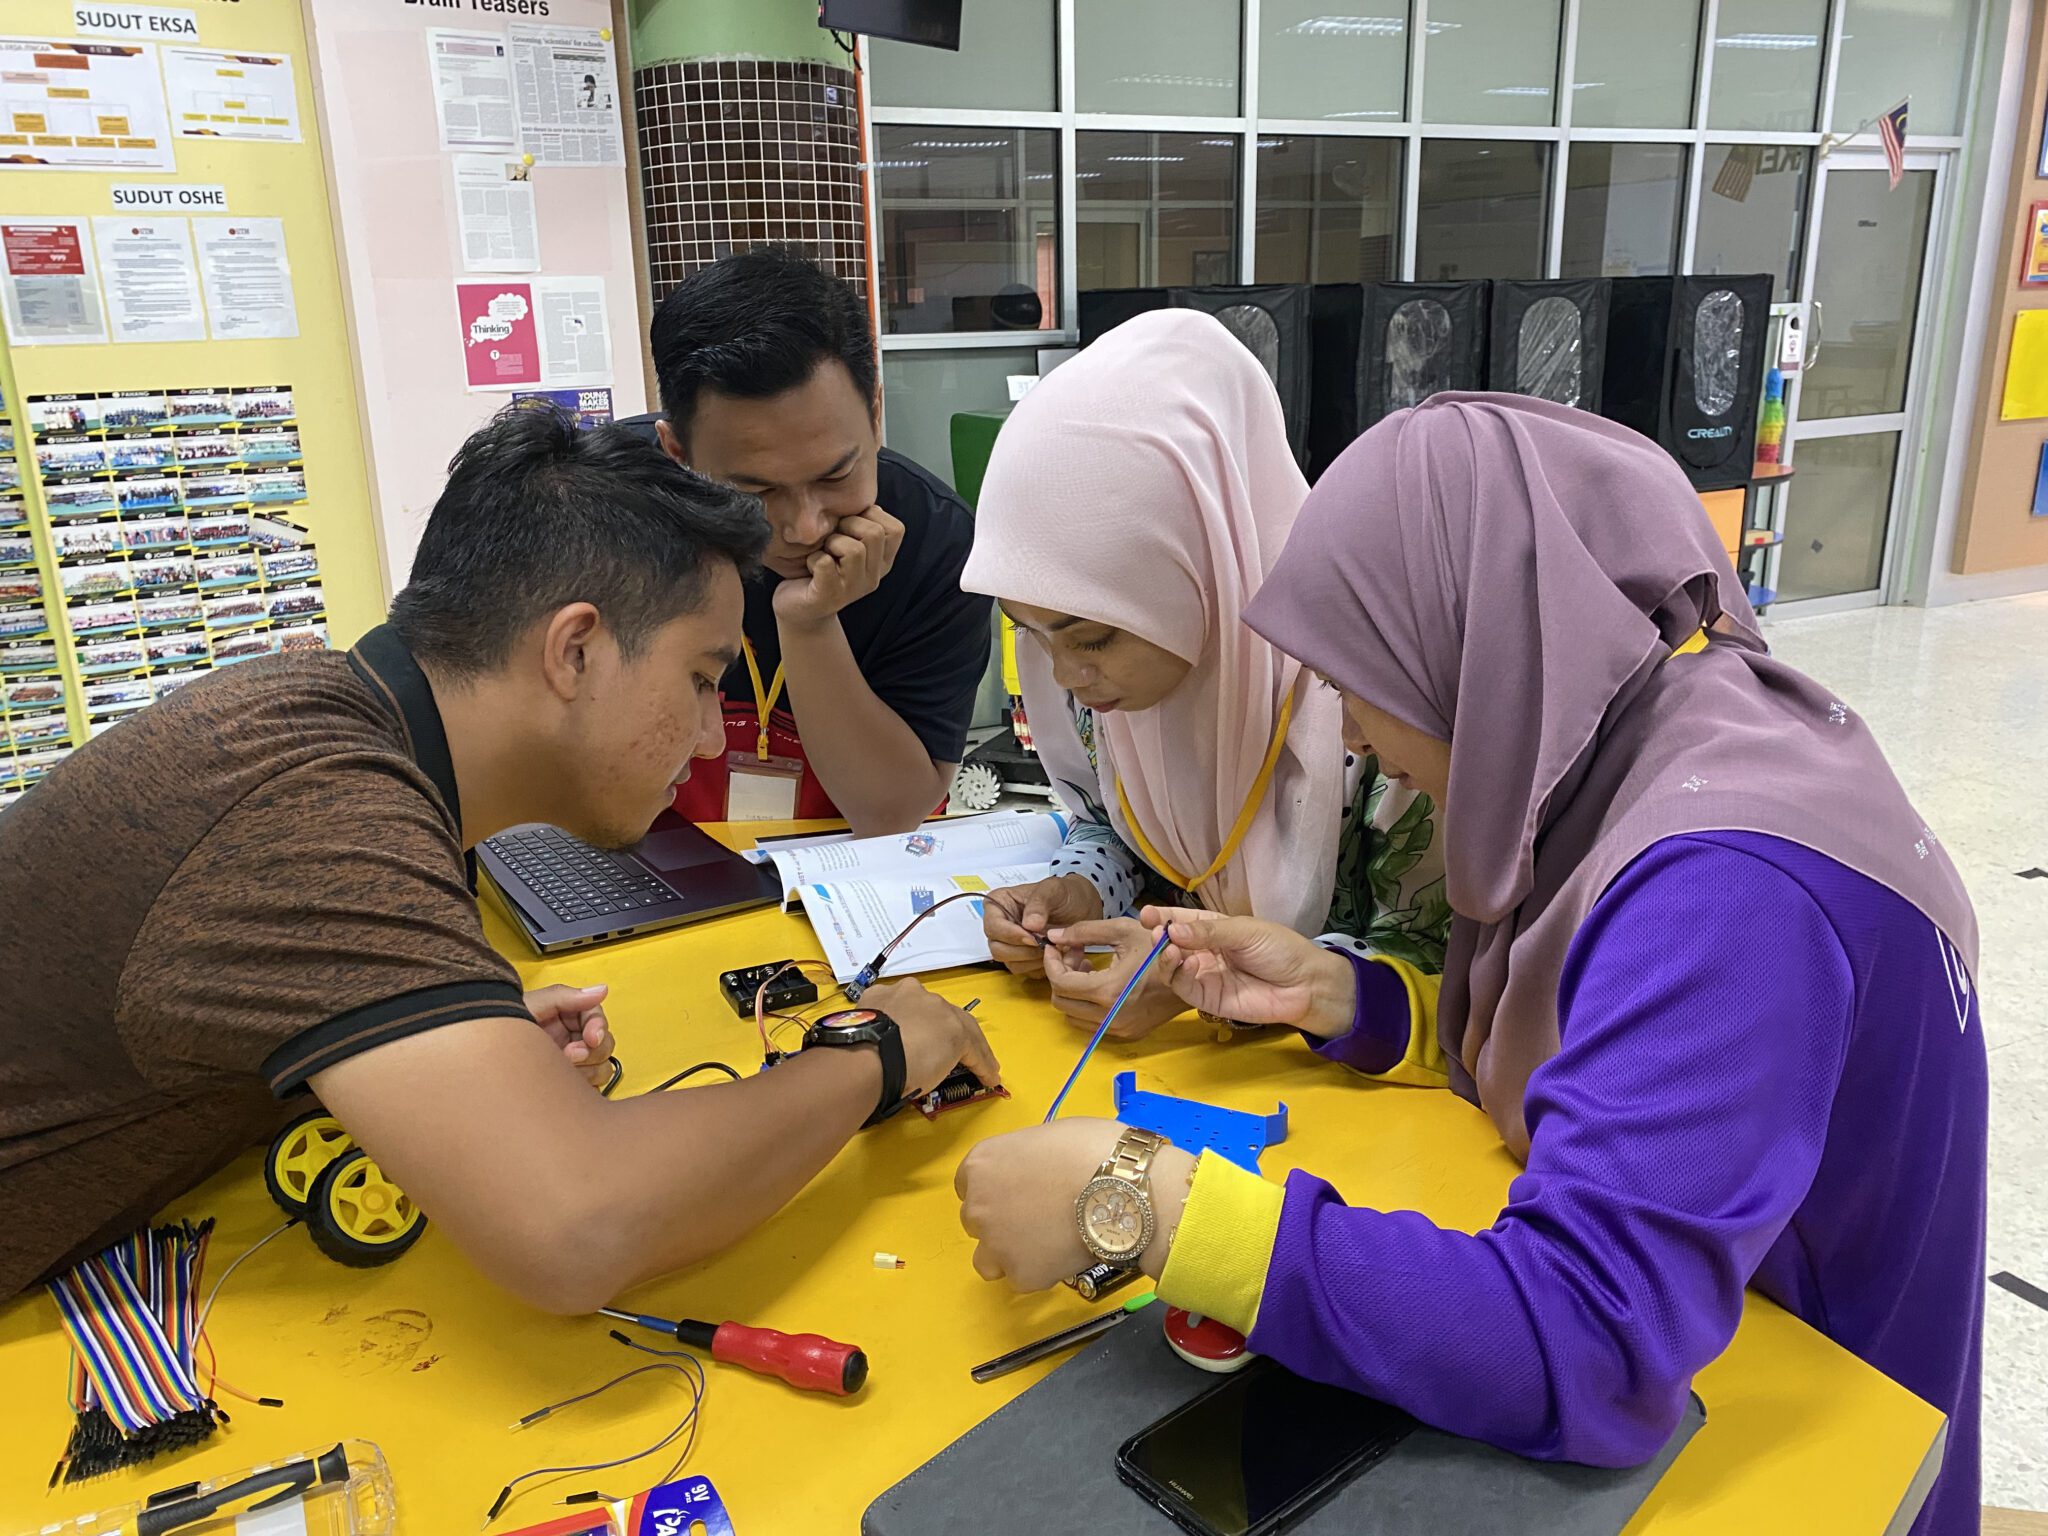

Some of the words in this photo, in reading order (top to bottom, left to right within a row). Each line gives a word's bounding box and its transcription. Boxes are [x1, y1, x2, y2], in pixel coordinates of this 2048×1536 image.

[76, 10, 143, 31] SUDUT
[149, 16, 197, 35] EKSA
[113, 190, 173, 205] SUDUT
[179, 190, 225, 205] OSHE
[472, 324, 510, 334] Thinking
[578, 391, 608, 401] YOUNG
[691, 1483, 711, 1502] 9V
